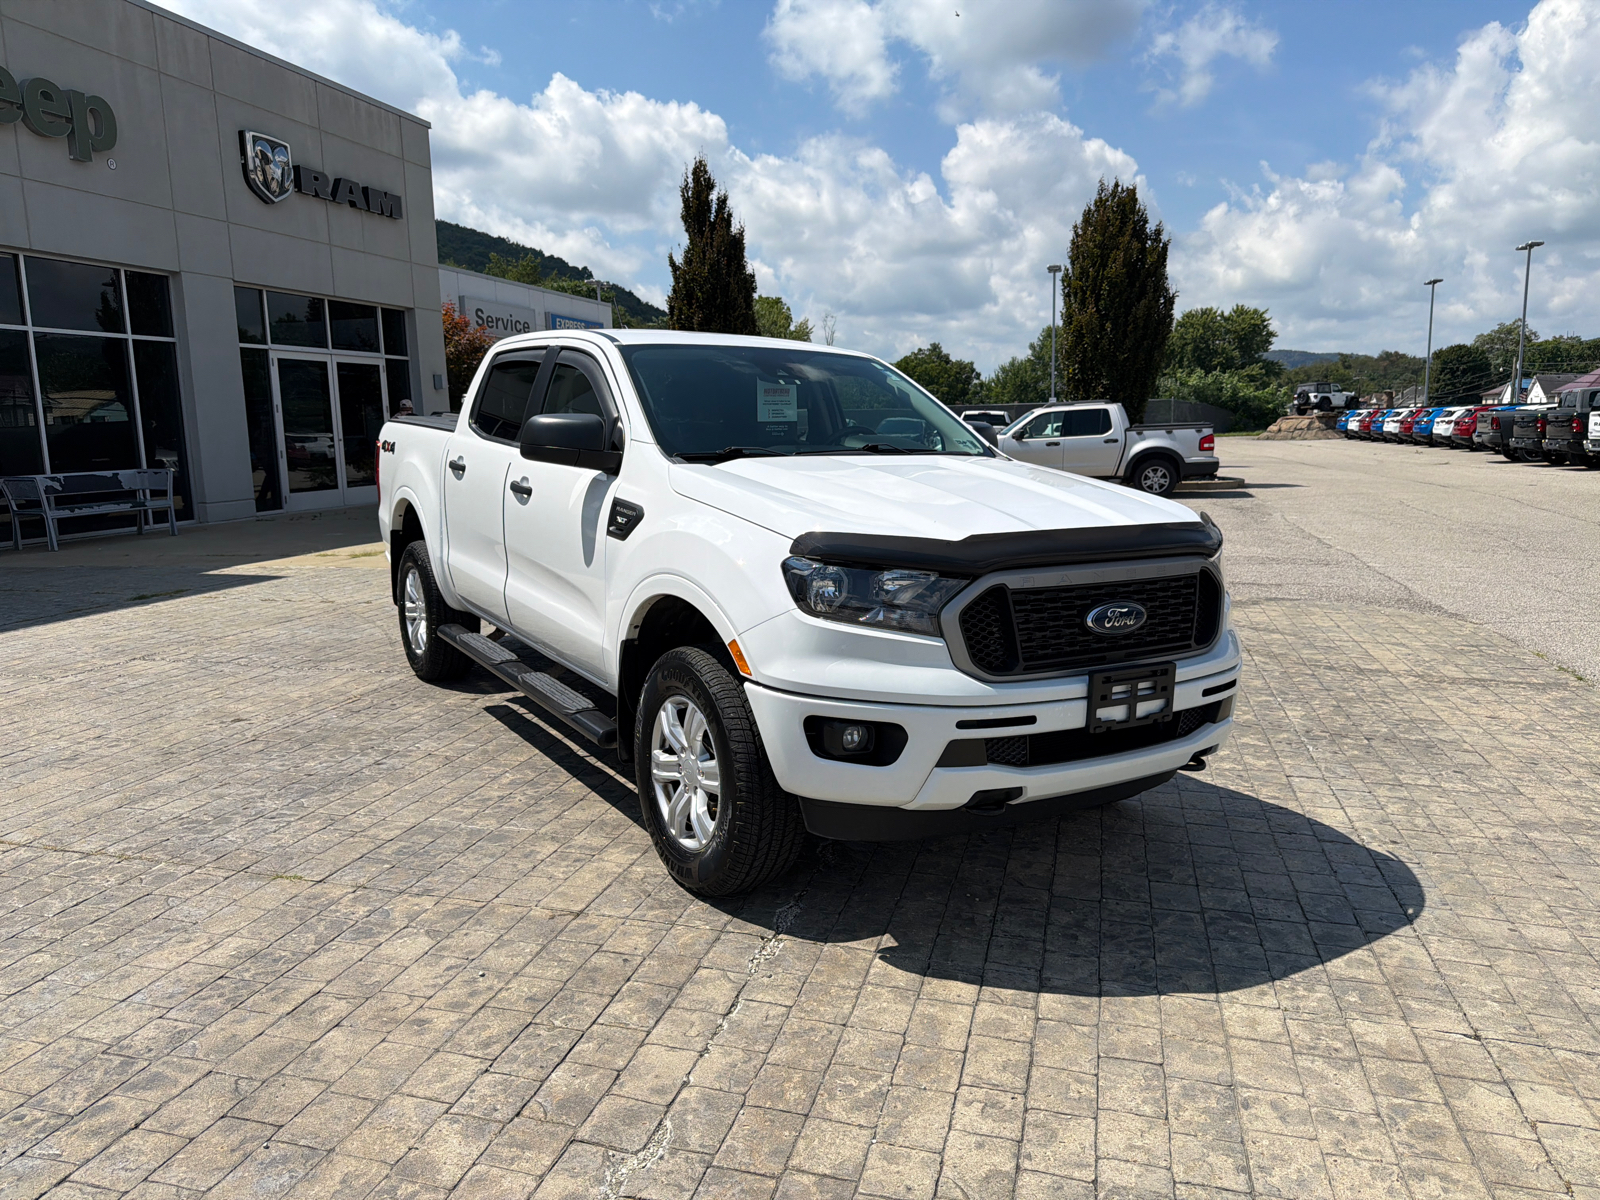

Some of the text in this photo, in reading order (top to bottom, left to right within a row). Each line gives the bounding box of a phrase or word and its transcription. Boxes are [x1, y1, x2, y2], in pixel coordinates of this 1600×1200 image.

[293, 164, 402, 219] RAM
[474, 307, 530, 333] Service
[1104, 607, 1137, 628] Ford
